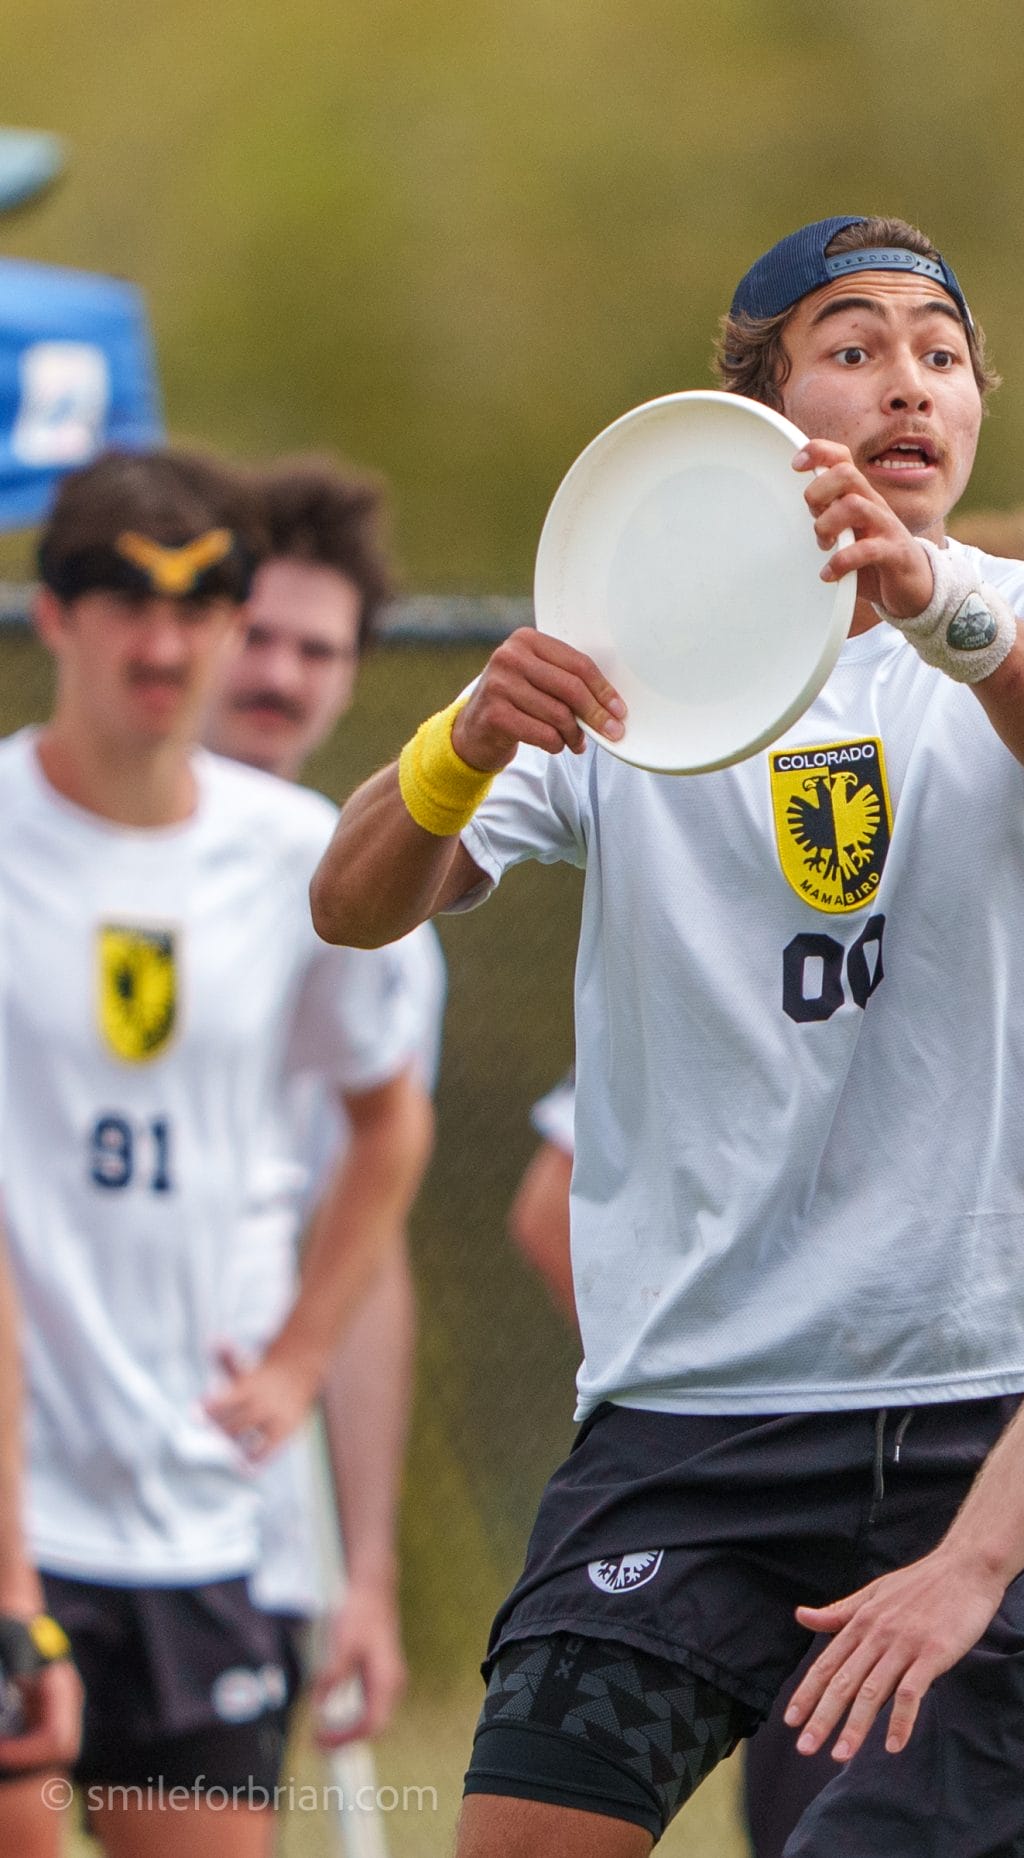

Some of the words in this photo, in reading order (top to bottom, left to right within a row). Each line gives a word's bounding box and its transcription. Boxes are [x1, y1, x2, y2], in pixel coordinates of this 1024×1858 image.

[777, 744, 876, 771] COLORADO
[800, 871, 880, 906] MAMABIRD
[782, 913, 886, 1024] 00
[90, 1112, 170, 1194] 91
